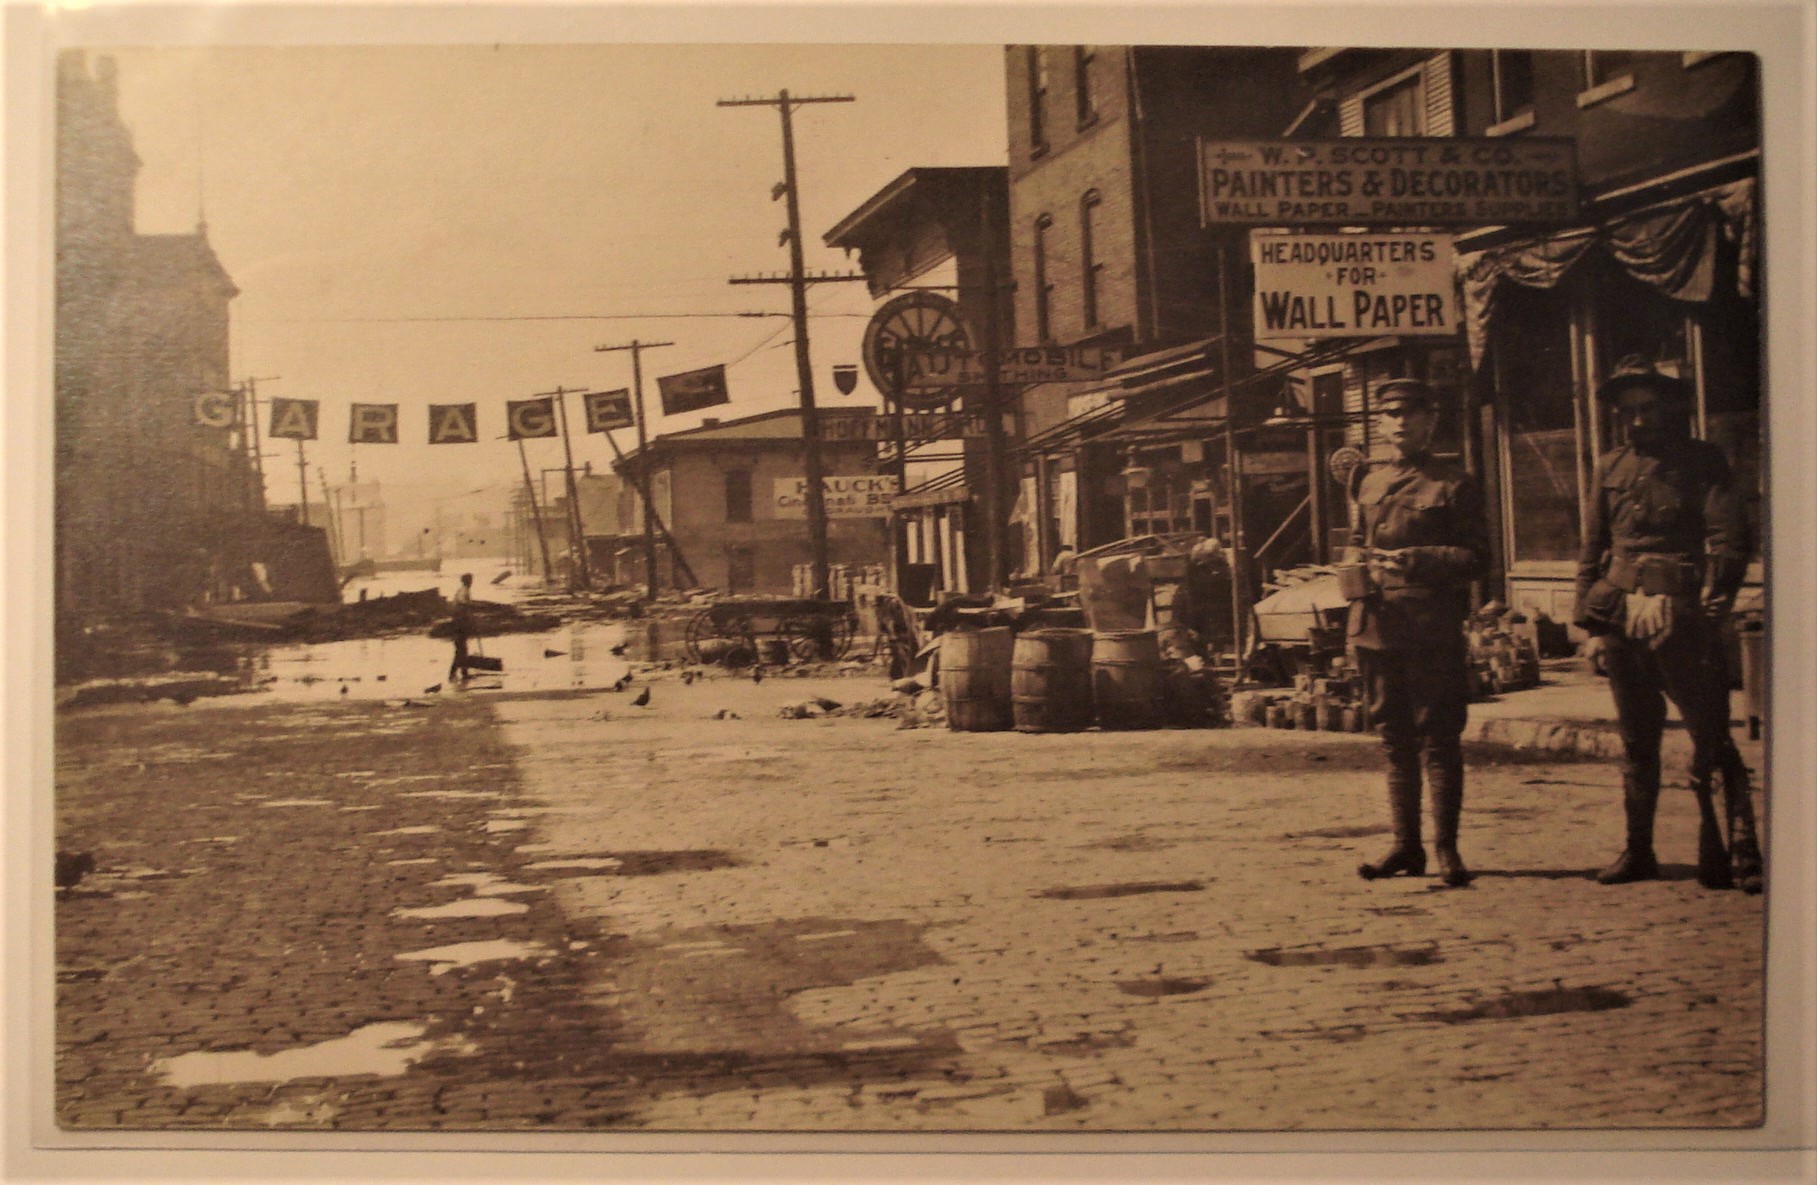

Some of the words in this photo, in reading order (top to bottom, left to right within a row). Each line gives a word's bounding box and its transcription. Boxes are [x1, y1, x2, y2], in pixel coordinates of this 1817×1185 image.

[1330, 146, 1428, 165] SCOTT
[1439, 147, 1460, 165] &
[1212, 168, 1352, 197] PAINTERS
[1361, 170, 1384, 197] &
[1391, 167, 1568, 198] DECORATORS
[1215, 202, 1271, 217] WALL
[1278, 200, 1348, 217] PAPER
[1261, 241, 1436, 265] HEADQUARTERS
[1260, 290, 1345, 329] WALL
[1353, 290, 1445, 329] PAPER
[195, 392, 630, 441] GARAGE
